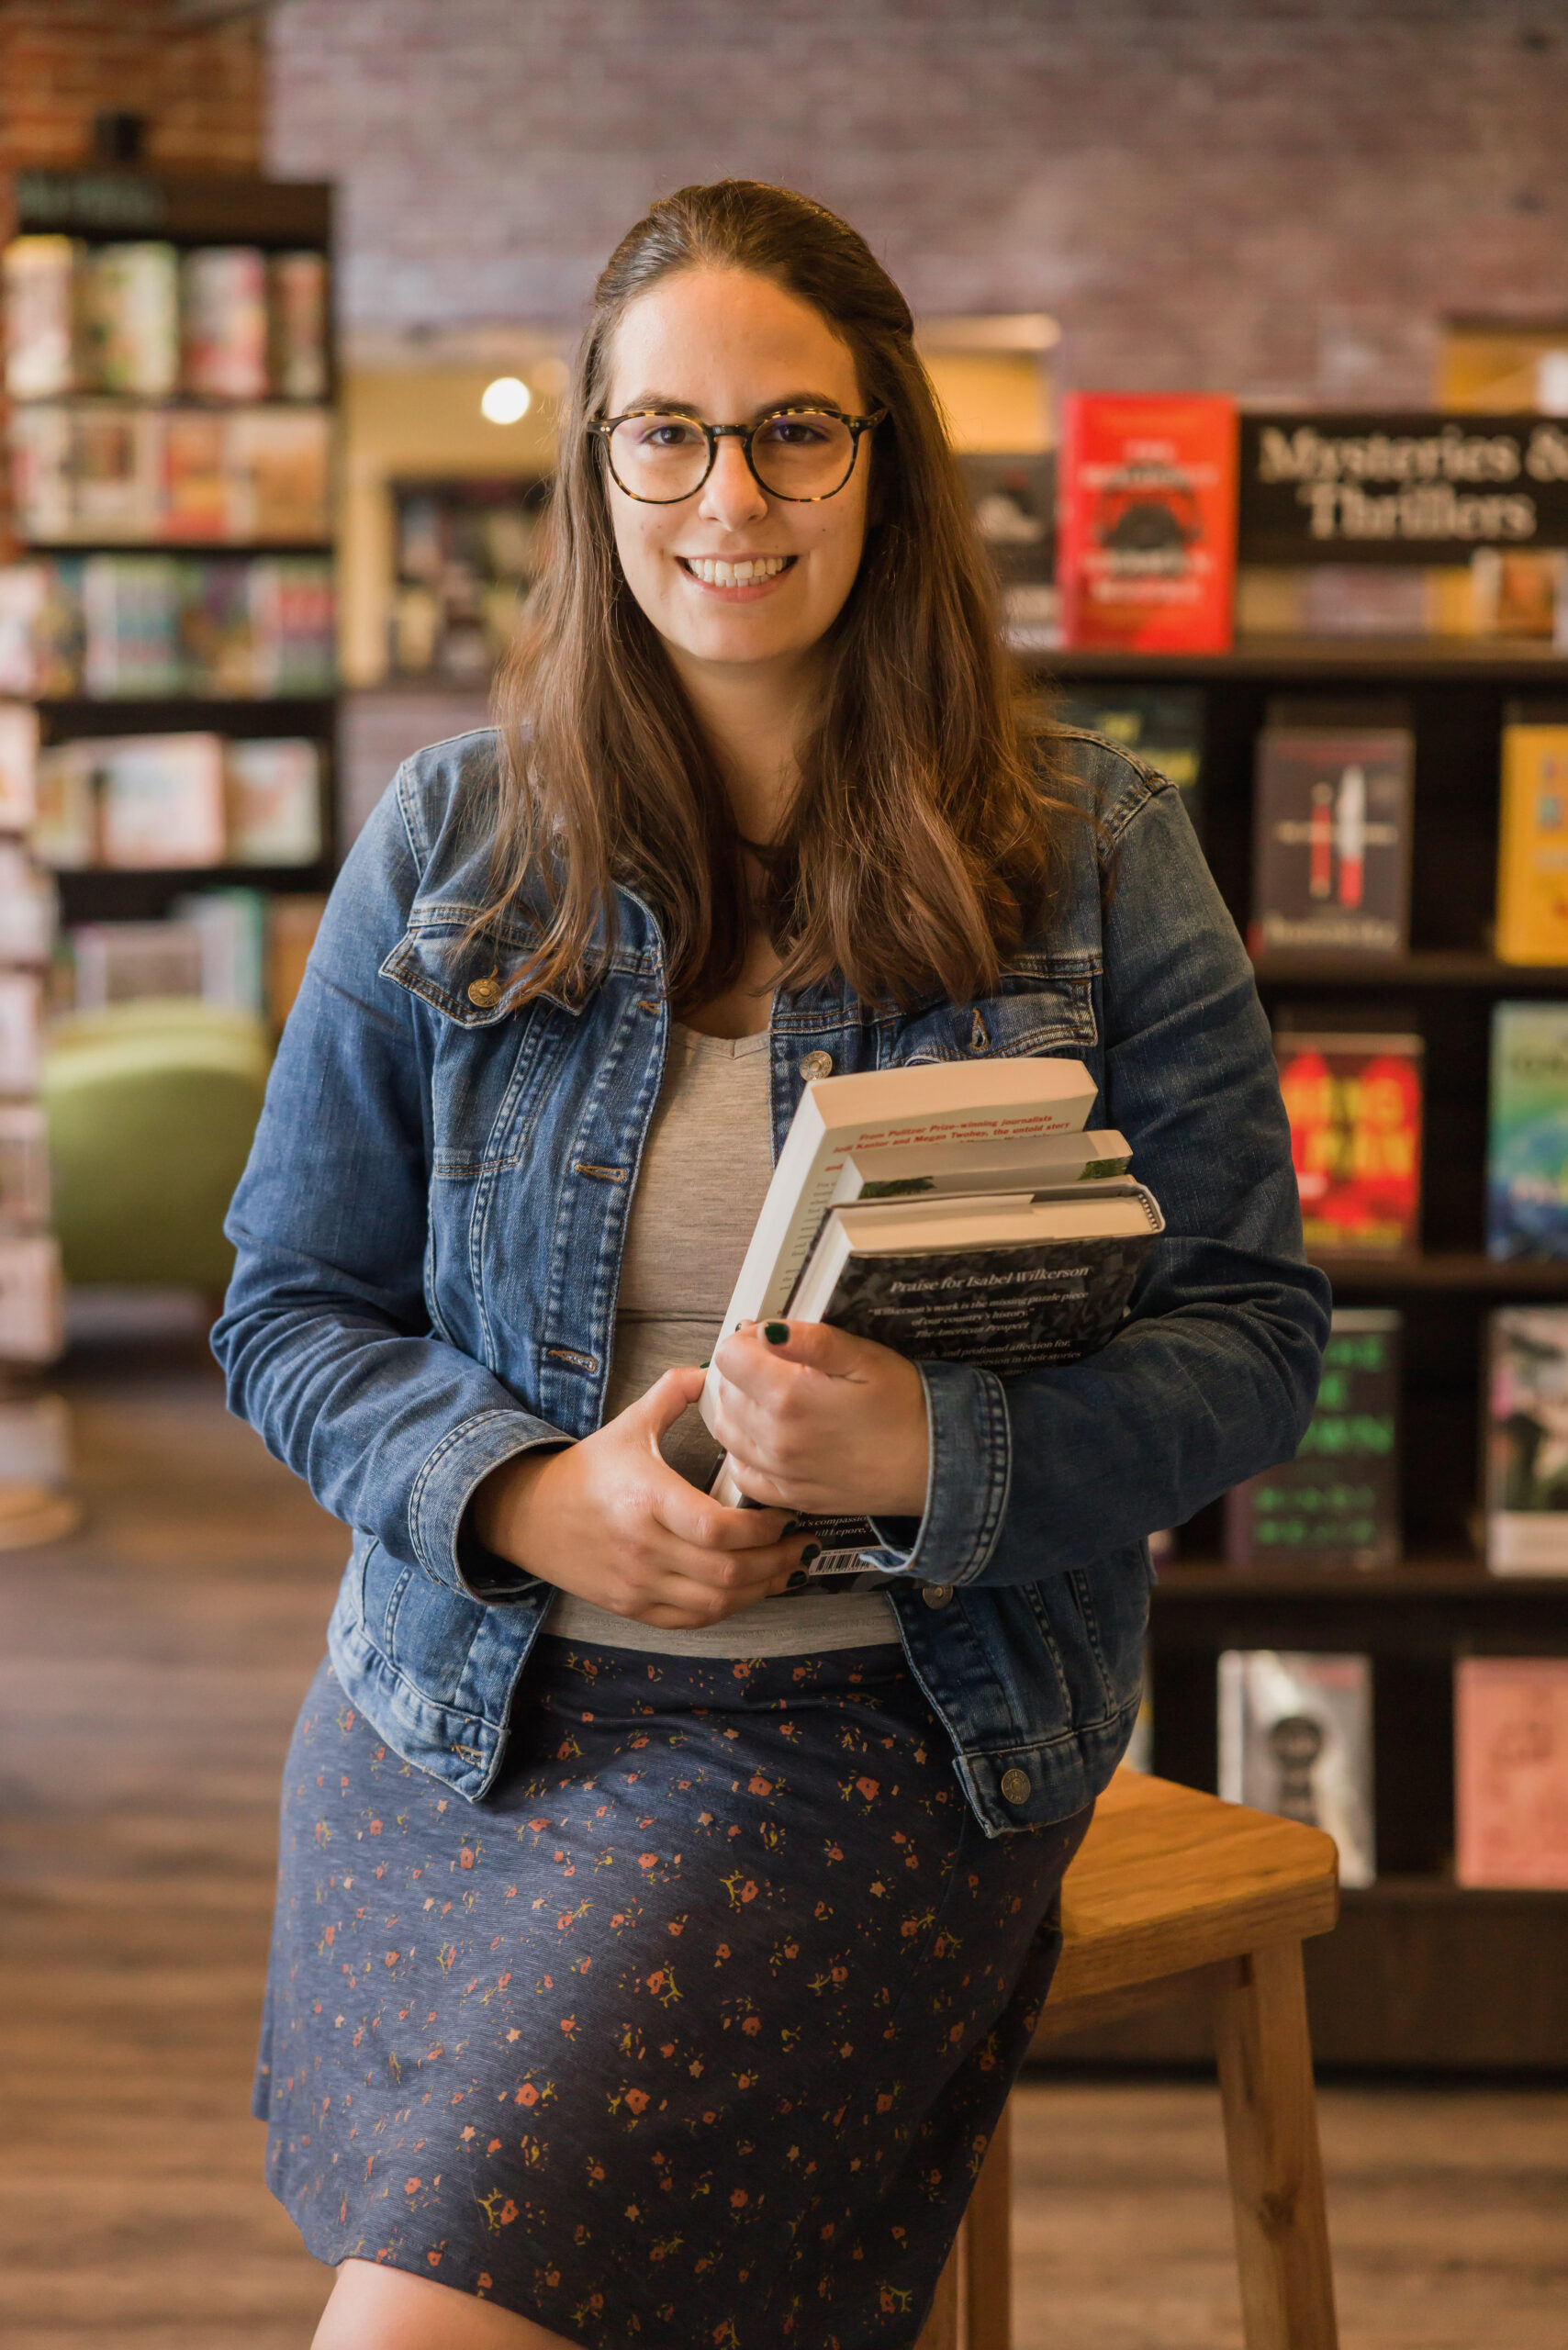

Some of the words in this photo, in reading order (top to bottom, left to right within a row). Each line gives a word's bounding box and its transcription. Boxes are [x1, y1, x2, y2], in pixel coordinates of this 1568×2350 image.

[1259, 425, 1520, 483] Mysteries
[1295, 480, 1537, 541] Thrillers
[1001, 1115, 1052, 1126] journalists
[892, 1137, 910, 1146] and
[913, 1135, 946, 1145] Megan
[993, 1126, 1009, 1136] the
[1013, 1125, 1044, 1134] untold
[1046, 1122, 1070, 1131] story
[890, 1280, 939, 1292] Praise
[940, 1276, 966, 1290] for
[967, 1273, 1014, 1287] Isabel
[1016, 1267, 1090, 1282] Wilkerson
[971, 1300, 986, 1309] the
[989, 1297, 1028, 1306] missing
[1029, 1293, 1060, 1305] puzzle
[1060, 1292, 1089, 1303] piece
[985, 1322, 1030, 1333] Prospect
[960, 1344, 1009, 1358] profound
[1009, 1341, 1054, 1352] affection
[1047, 1351, 1082, 1360] stories
[814, 1515, 868, 1526] compassio
